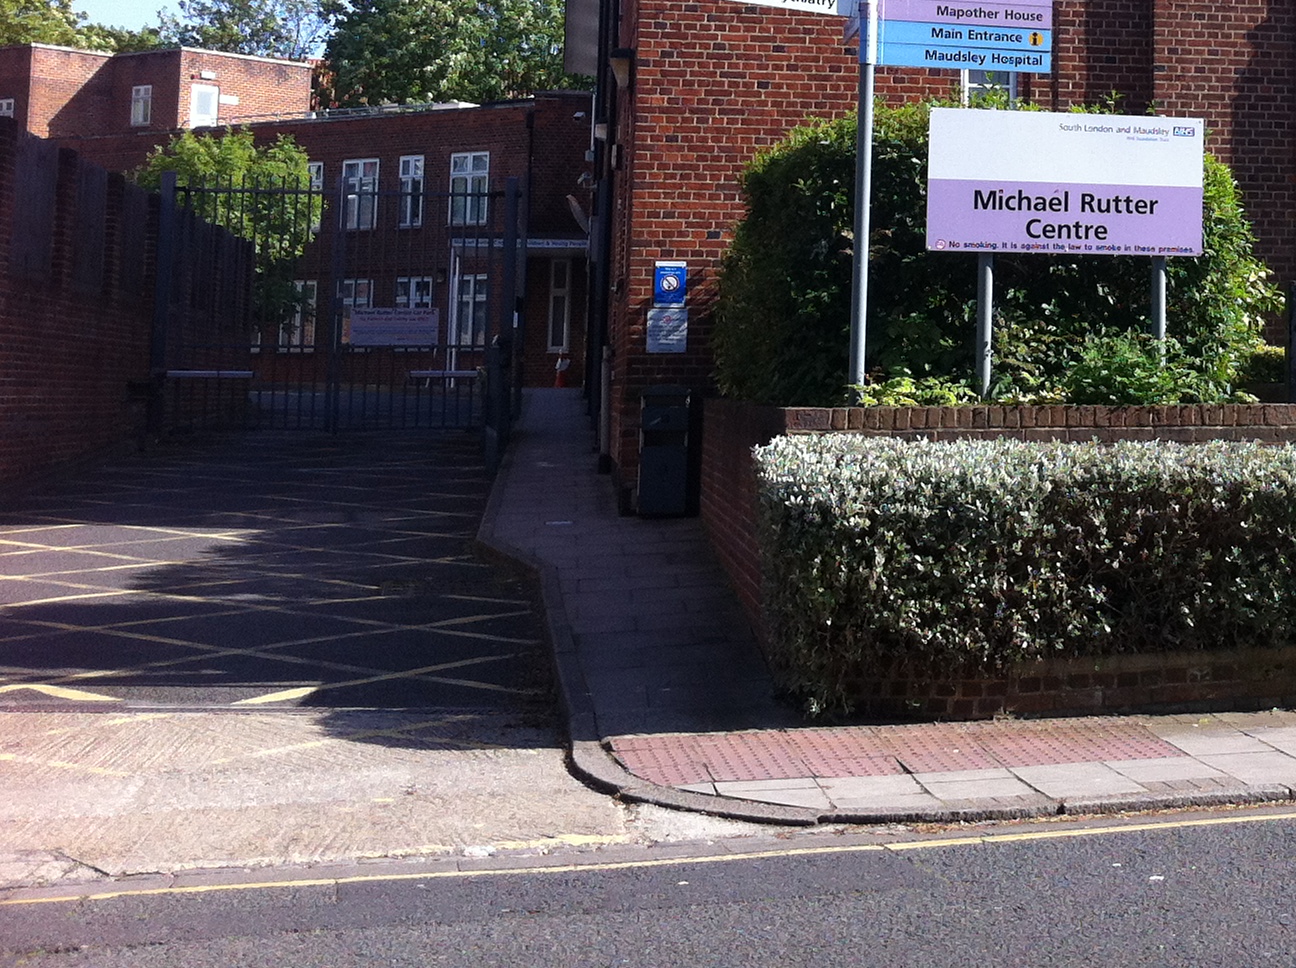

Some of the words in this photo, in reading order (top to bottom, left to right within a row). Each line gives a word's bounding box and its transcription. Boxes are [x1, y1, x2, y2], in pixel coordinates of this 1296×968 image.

[936, 5, 1000, 21] Mapother
[1005, 9, 1043, 22] House
[931, 27, 963, 40] Main
[968, 29, 1023, 43] Entrance
[925, 49, 986, 65] Maudsley
[991, 53, 1043, 67] Hospital
[1059, 122, 1082, 132] South
[1084, 124, 1114, 133] London
[1116, 126, 1131, 134] and
[1133, 126, 1170, 137] Maudsley
[973, 189, 1069, 213] Michael
[1080, 193, 1159, 214] Rutter
[1025, 218, 1108, 241] Centre
[964, 241, 999, 251] smoking.
[1002, 241, 1007, 249] It
[1020, 242, 1049, 251] against
[1053, 242, 1065, 250] the
[1068, 243, 1081, 251] law
[1124, 244, 1131, 252] in
[1134, 244, 1155, 252] these
